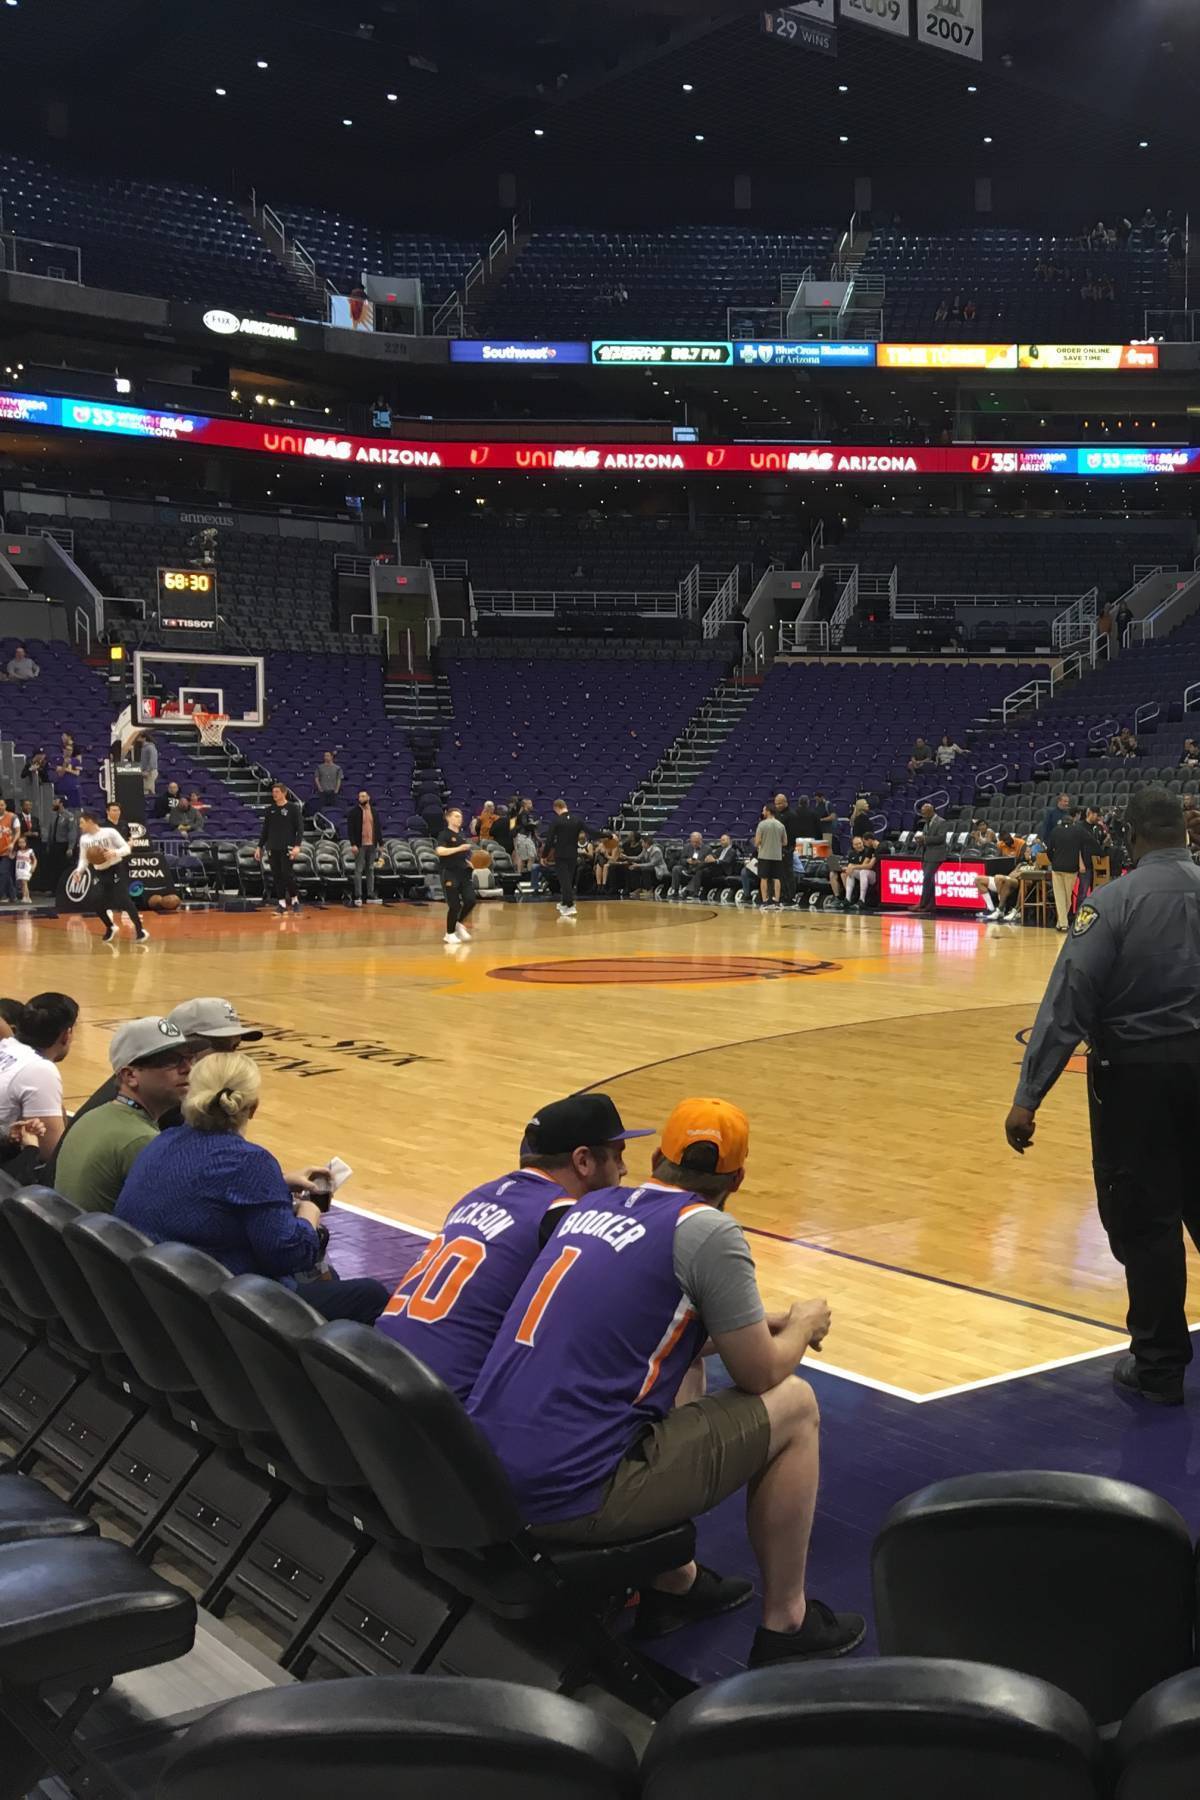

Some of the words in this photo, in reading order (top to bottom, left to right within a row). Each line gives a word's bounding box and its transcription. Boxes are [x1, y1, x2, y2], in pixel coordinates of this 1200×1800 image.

[776, 17, 797, 39] 29
[802, 31, 829, 49] WINS
[926, 13, 974, 46] 2007
[482, 345, 548, 360] Southwest
[356, 447, 441, 467] ARIZONA
[604, 453, 684, 469] ARIZONA
[838, 454, 917, 471] ARIZONA
[992, 452, 1015, 472] 35
[180, 510, 234, 526] annexus
[165, 573, 209, 592] 68:30
[177, 619, 214, 629] TISSOT
[128, 857, 159, 868] SINO
[889, 884, 909, 894] TILE
[947, 887, 979, 899] STONE
[556, 1210, 647, 1253] BOOKER
[381, 1233, 487, 1324] 20
[515, 1245, 582, 1348] 1
